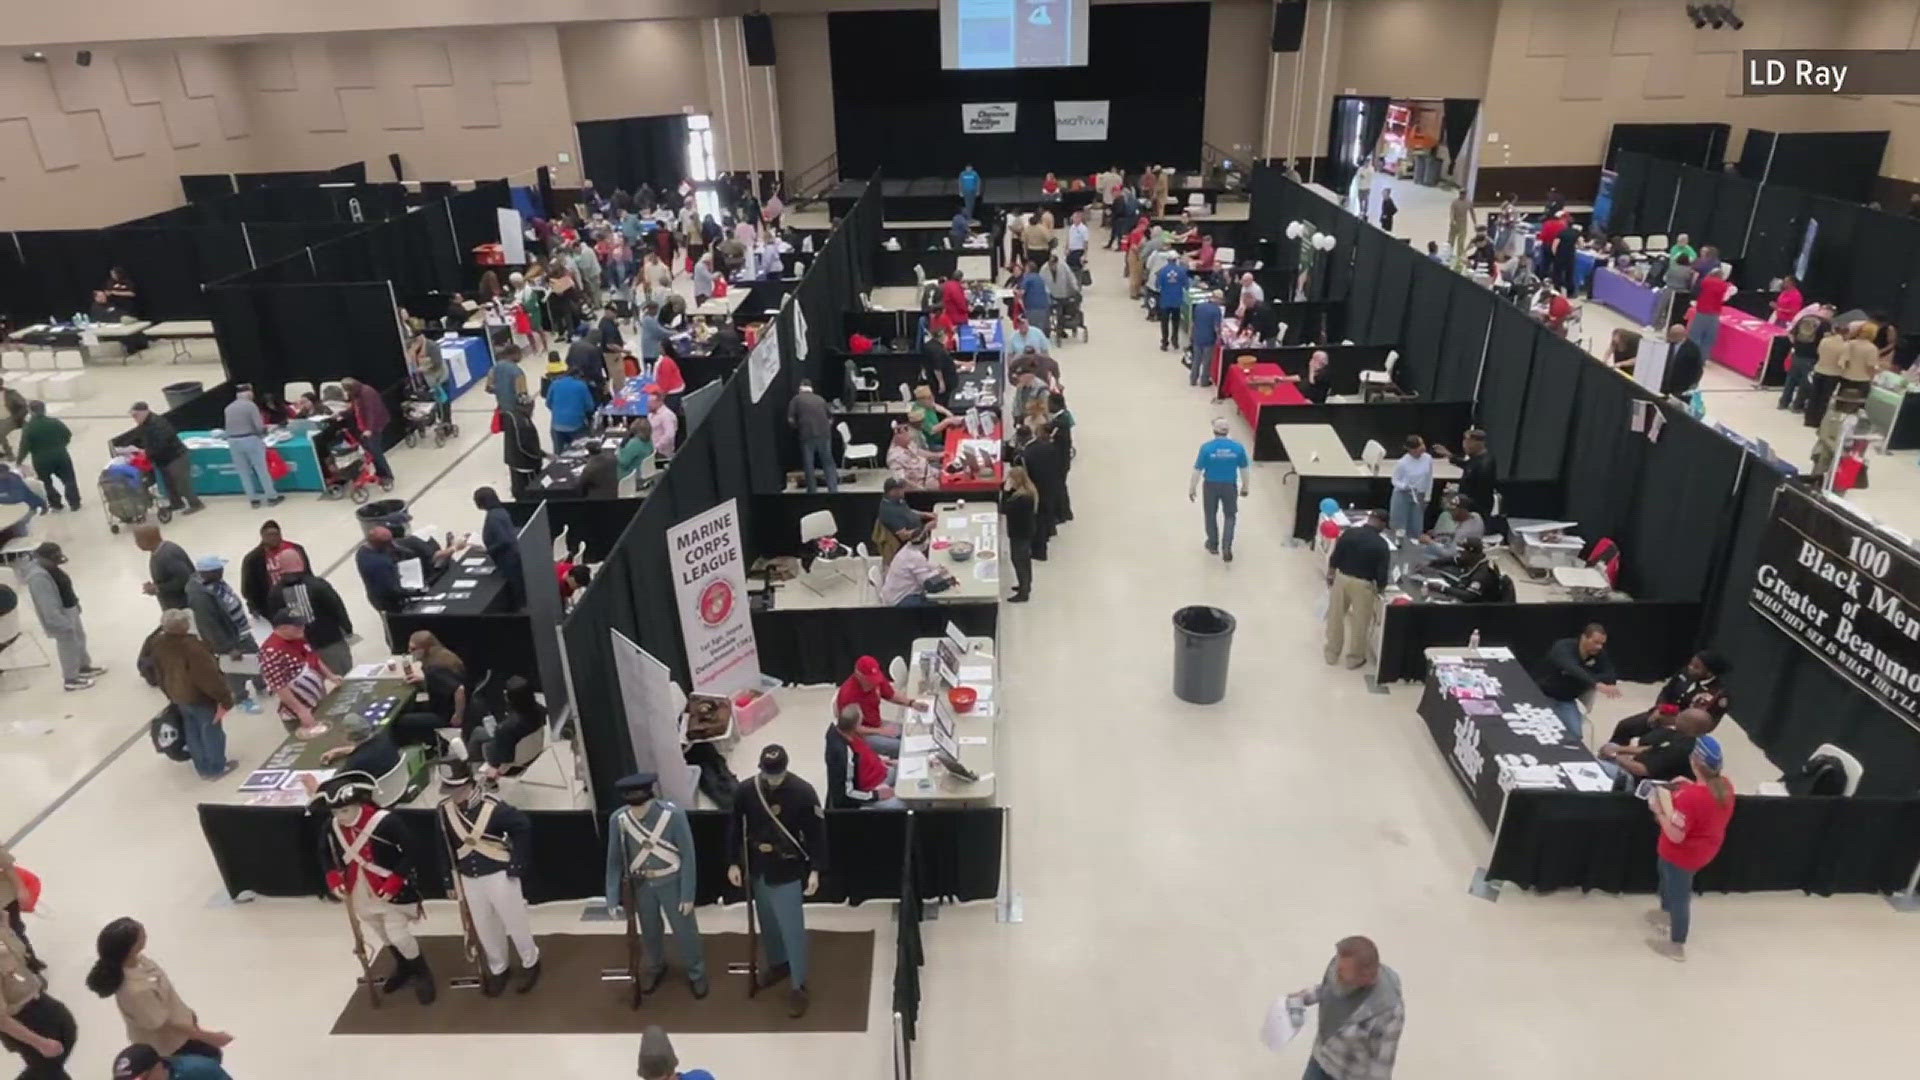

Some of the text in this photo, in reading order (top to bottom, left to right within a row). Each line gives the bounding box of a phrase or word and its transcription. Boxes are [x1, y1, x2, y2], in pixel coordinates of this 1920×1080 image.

[676, 513, 732, 551] MARINE
[685, 532, 731, 565] CORPS
[682, 547, 738, 585] LEAGUE
[1847, 536, 1891, 578] 100
[1757, 564, 1829, 627] Greater
[1797, 540, 1920, 641] Black Men
[1841, 601, 1861, 620] of
[1781, 608, 1807, 632] THEY
[1804, 627, 1827, 647] SEE
[1824, 640, 1839, 655] IS
[1838, 650, 1872, 679] WHAT
[1871, 673, 1917, 713] THEY'LL
